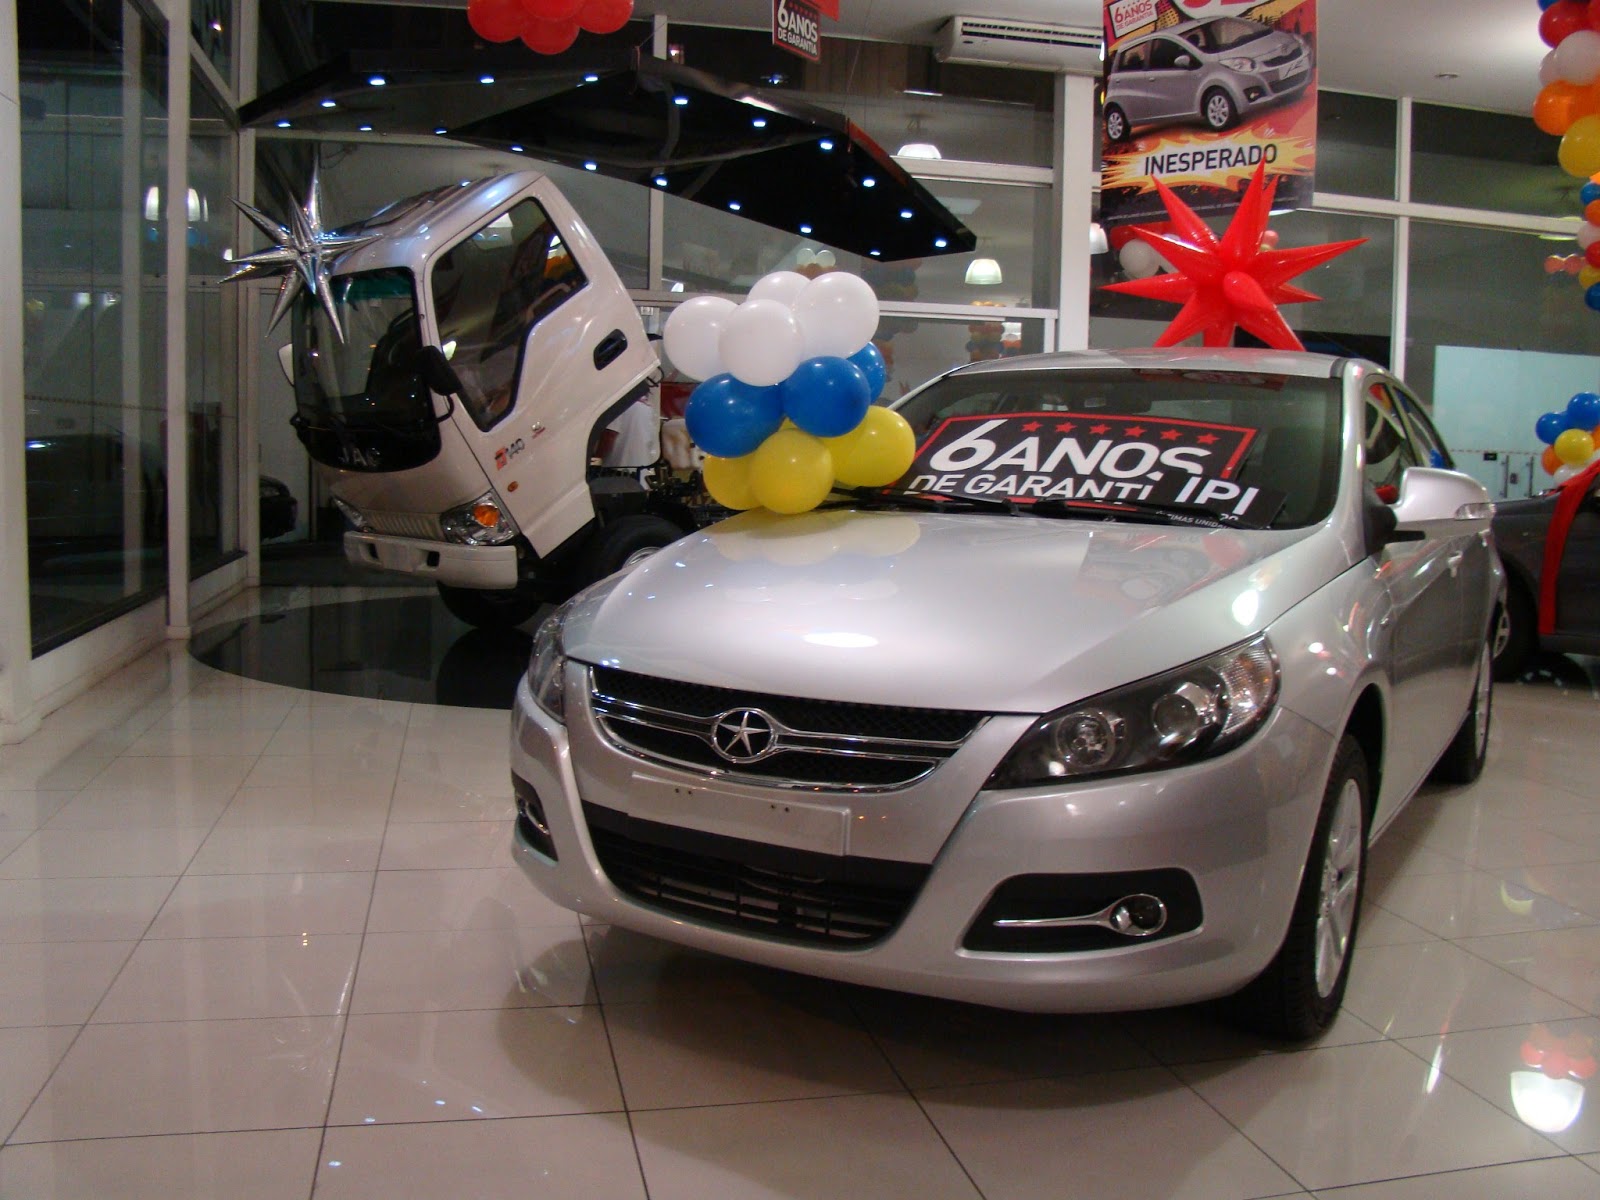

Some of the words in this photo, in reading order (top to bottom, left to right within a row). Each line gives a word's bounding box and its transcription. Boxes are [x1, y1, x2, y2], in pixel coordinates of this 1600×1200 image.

[778, 28, 787, 41] DE
[788, 32, 817, 55] GARANTIA
[1144, 143, 1277, 176] INESPERADO
[963, 474, 1154, 504] GARANTI
[1174, 476, 1260, 516] IPI
